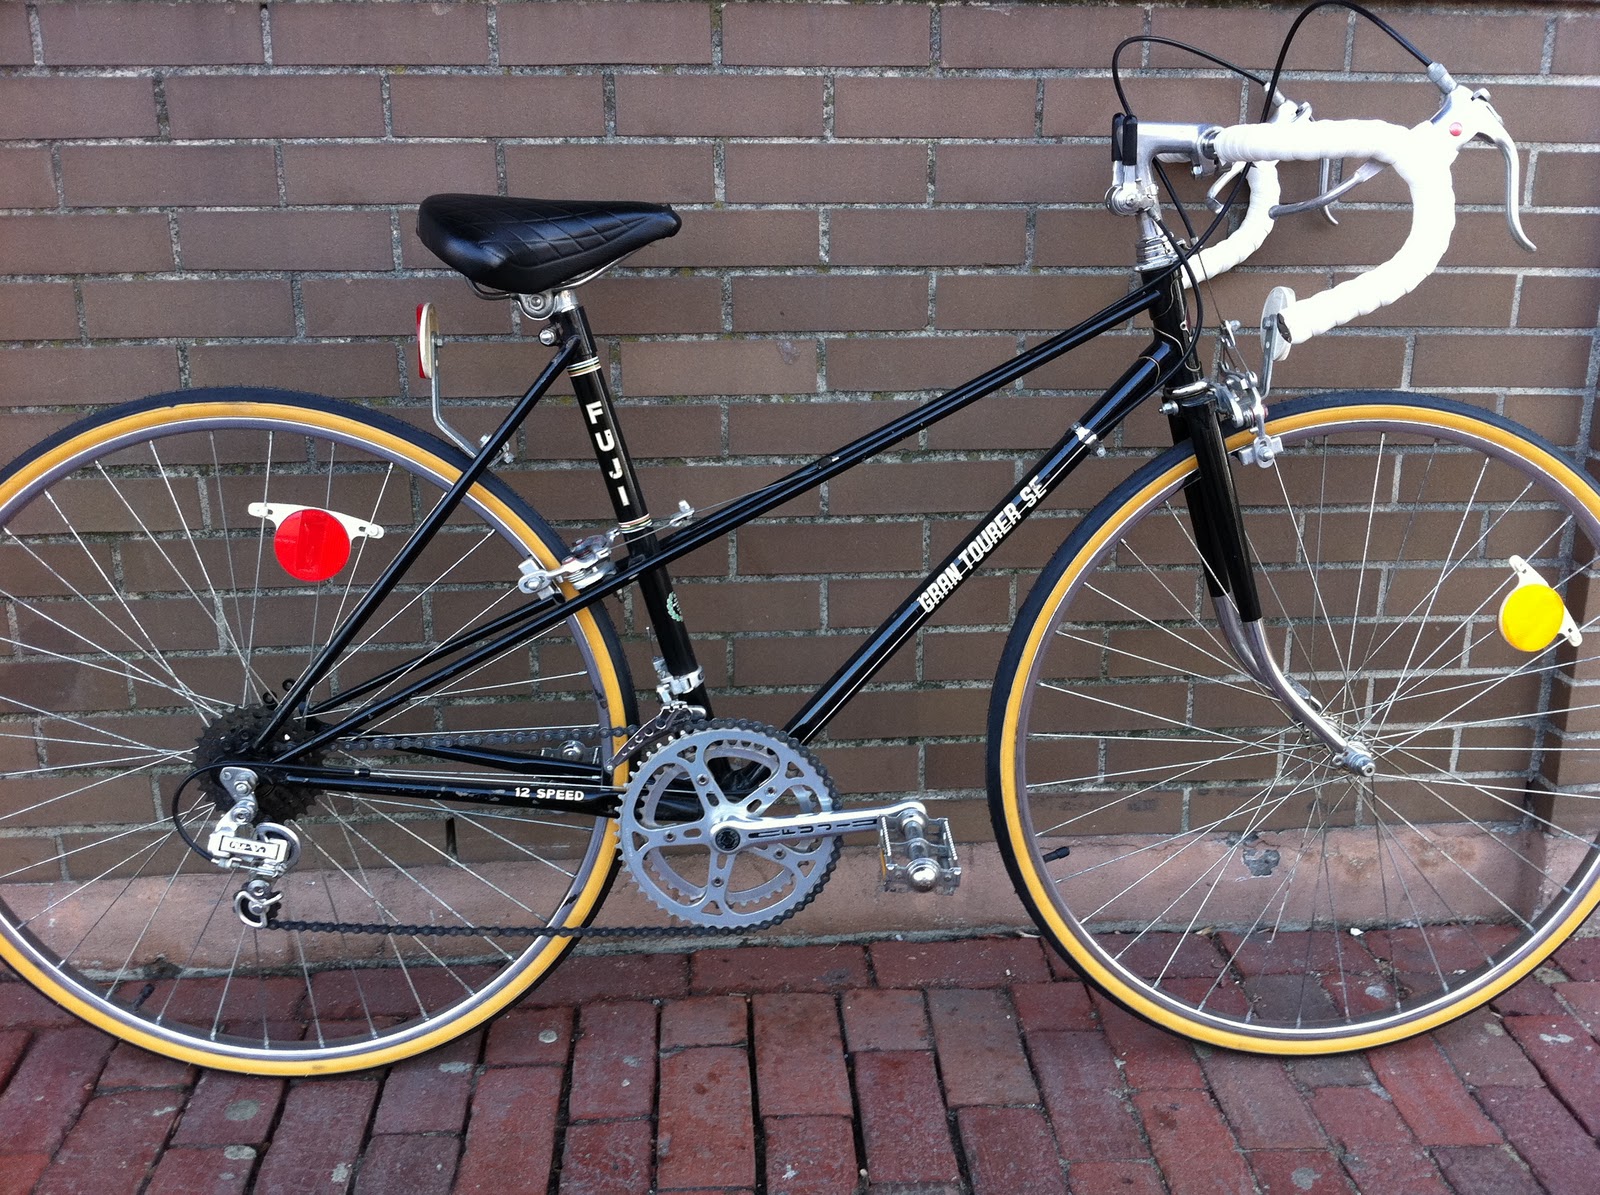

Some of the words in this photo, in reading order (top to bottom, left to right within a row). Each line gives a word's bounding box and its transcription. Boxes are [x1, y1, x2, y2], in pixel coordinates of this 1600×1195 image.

[585, 401, 630, 506] FUJI
[917, 562, 963, 613] GRAN
[958, 502, 1022, 570] TOURER
[1019, 475, 1047, 508] SE
[514, 787, 531, 798] 12
[536, 788, 585, 801] SPEED
[781, 823, 851, 836] FUJI
